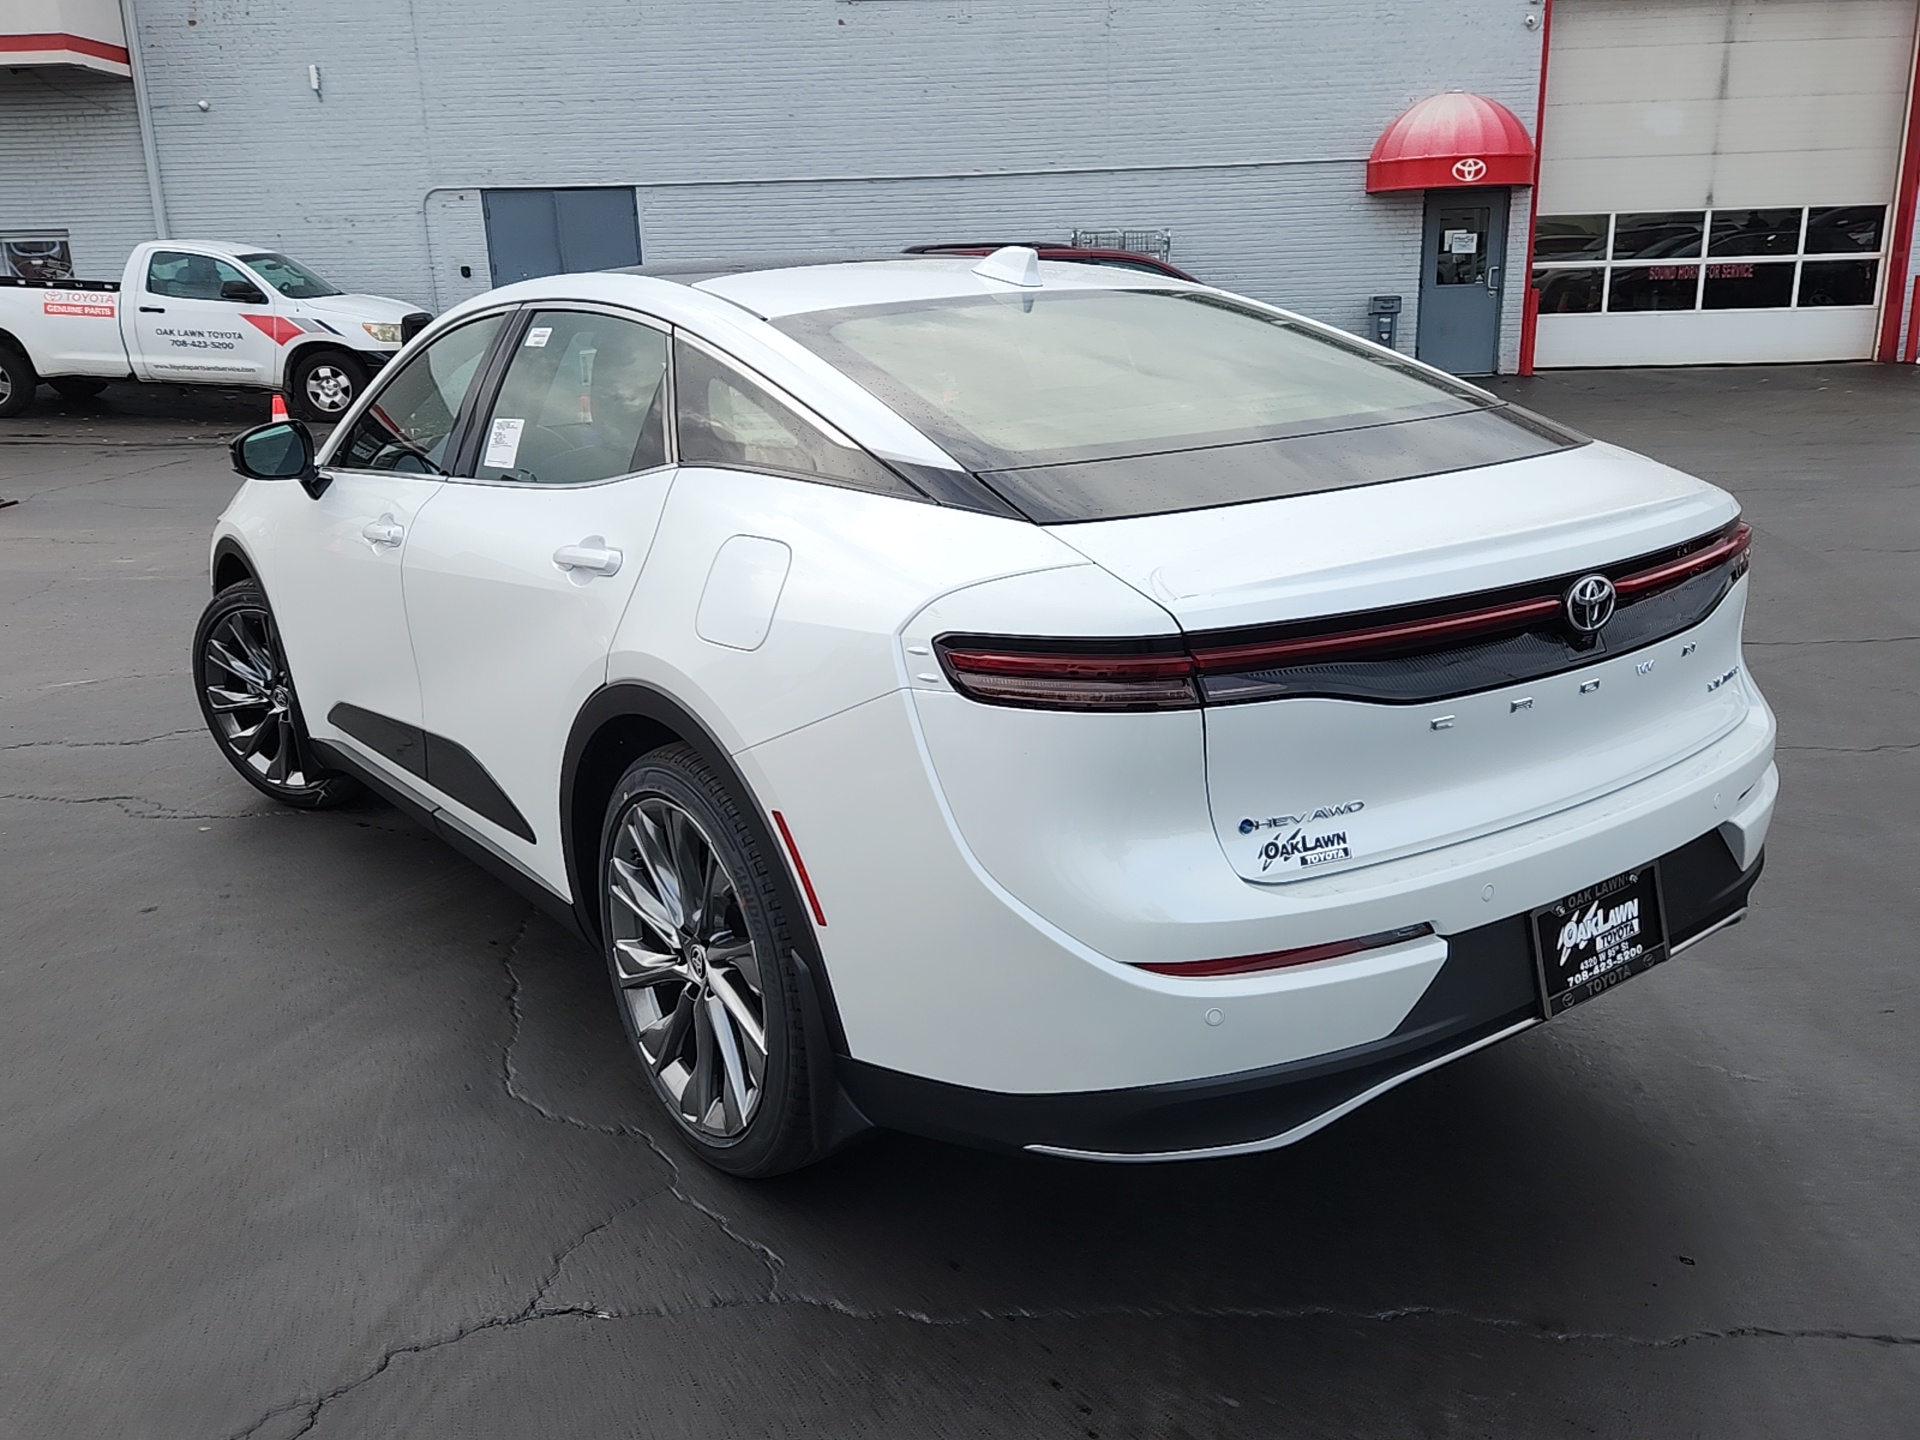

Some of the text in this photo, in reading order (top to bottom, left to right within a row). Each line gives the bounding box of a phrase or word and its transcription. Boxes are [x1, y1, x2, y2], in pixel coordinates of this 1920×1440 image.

[1721, 263, 1754, 278] SERVICE
[65, 292, 115, 304] TOYOTA
[46, 304, 112, 316] GENUINE PARTS
[155, 328, 244, 340] OAK LAWN TOYOTA
[169, 339, 235, 350] 708-423-5200
[1253, 801, 1365, 831] HEV AWD
[1305, 849, 1346, 865] TOYOTA
[1568, 875, 1626, 908] OAK LAWN
[1601, 922, 1636, 948] TOYOTA
[1567, 944, 1643, 987] 708-423-5200
[1580, 955, 1598, 970] 4320
[1598, 951, 1607, 962] W
[1586, 965, 1632, 996] TOYOTA
